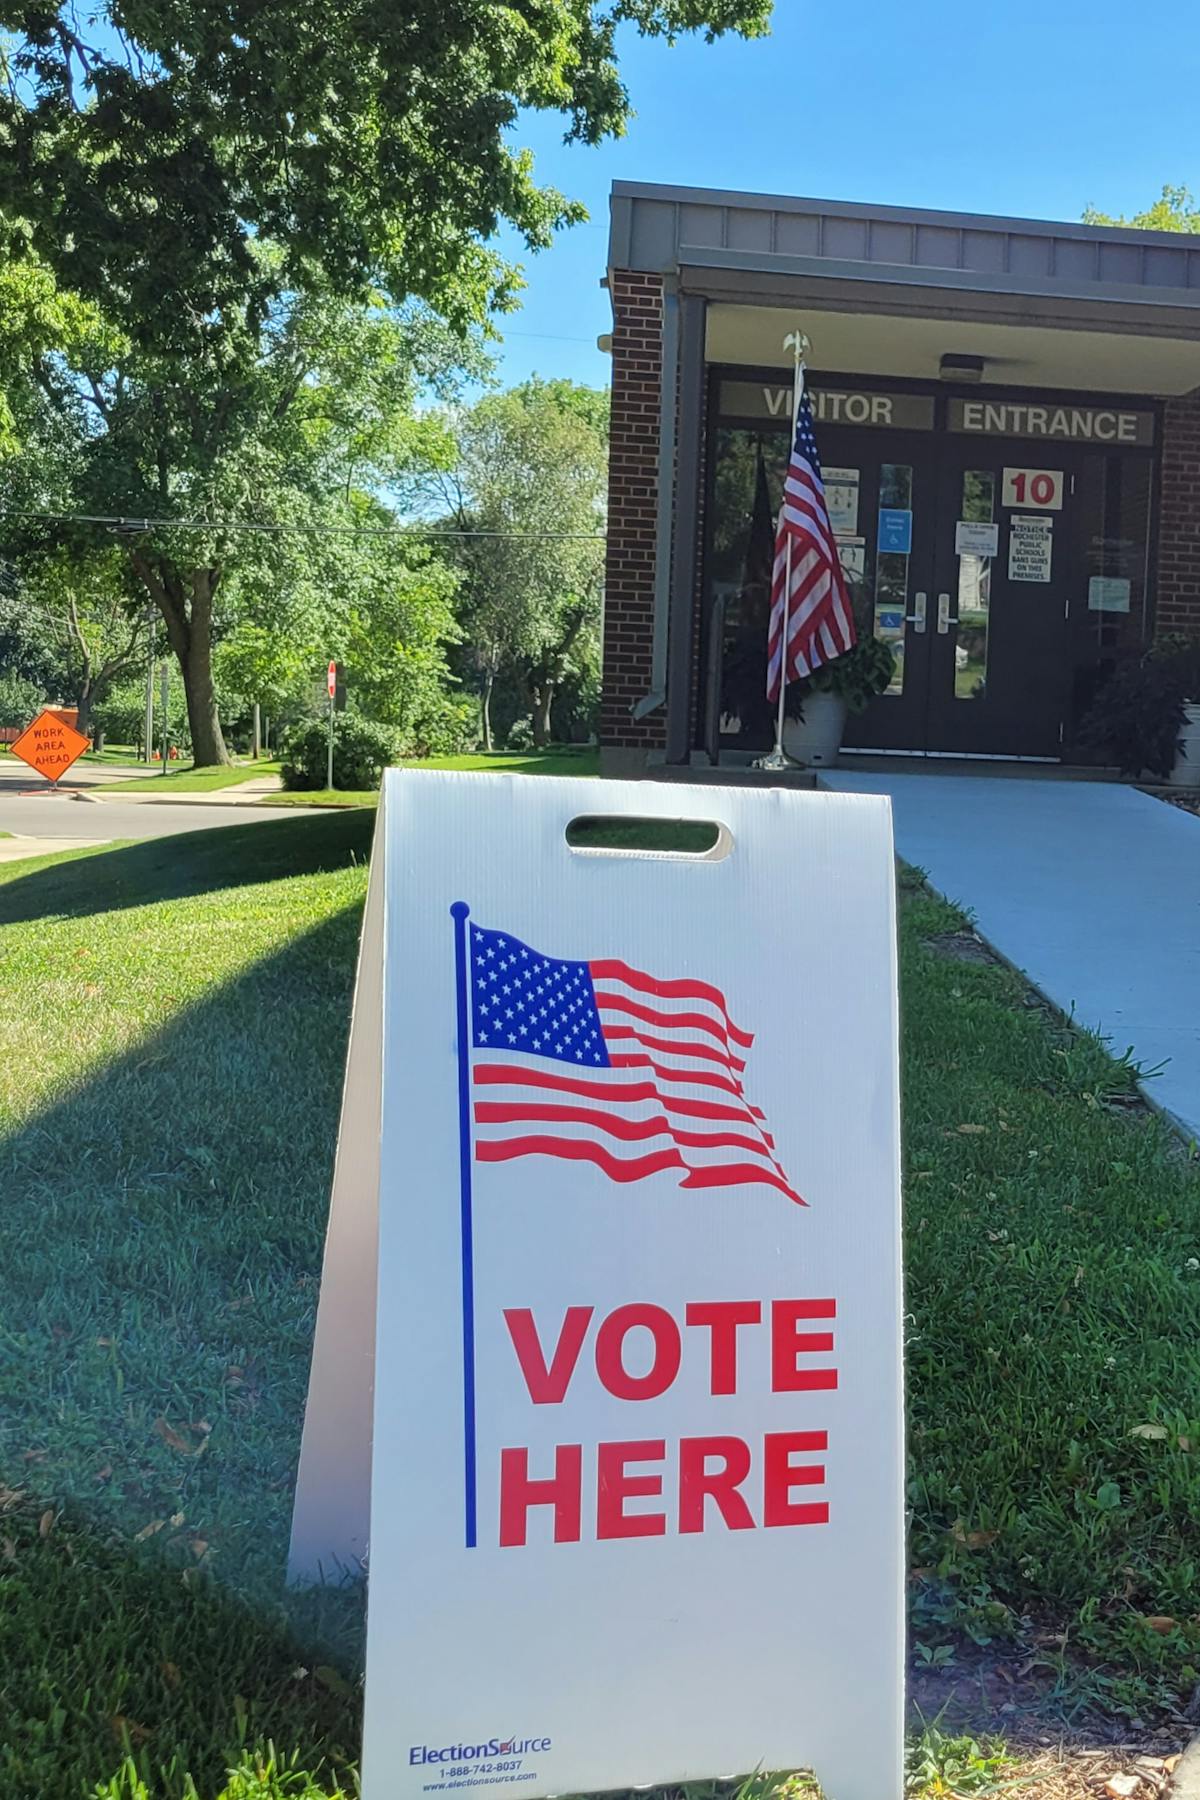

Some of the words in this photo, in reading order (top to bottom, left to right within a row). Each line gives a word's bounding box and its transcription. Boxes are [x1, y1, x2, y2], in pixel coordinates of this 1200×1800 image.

[963, 404, 1138, 441] ENTRANCE
[1010, 472, 1055, 505] 10
[1012, 556, 1029, 564] BANS
[1030, 558, 1048, 566] GUNS
[1016, 549, 1046, 557] SCHOOLS
[33, 728, 64, 739] WORK
[35, 741, 65, 752] AREA
[35, 754, 70, 765] AHEAD
[501, 1298, 838, 1404] VOTE
[499, 1430, 829, 1548] HERE
[440, 1760, 523, 1778] 1-888-742-8037
[423, 1771, 537, 1792] www.electionsource.com
